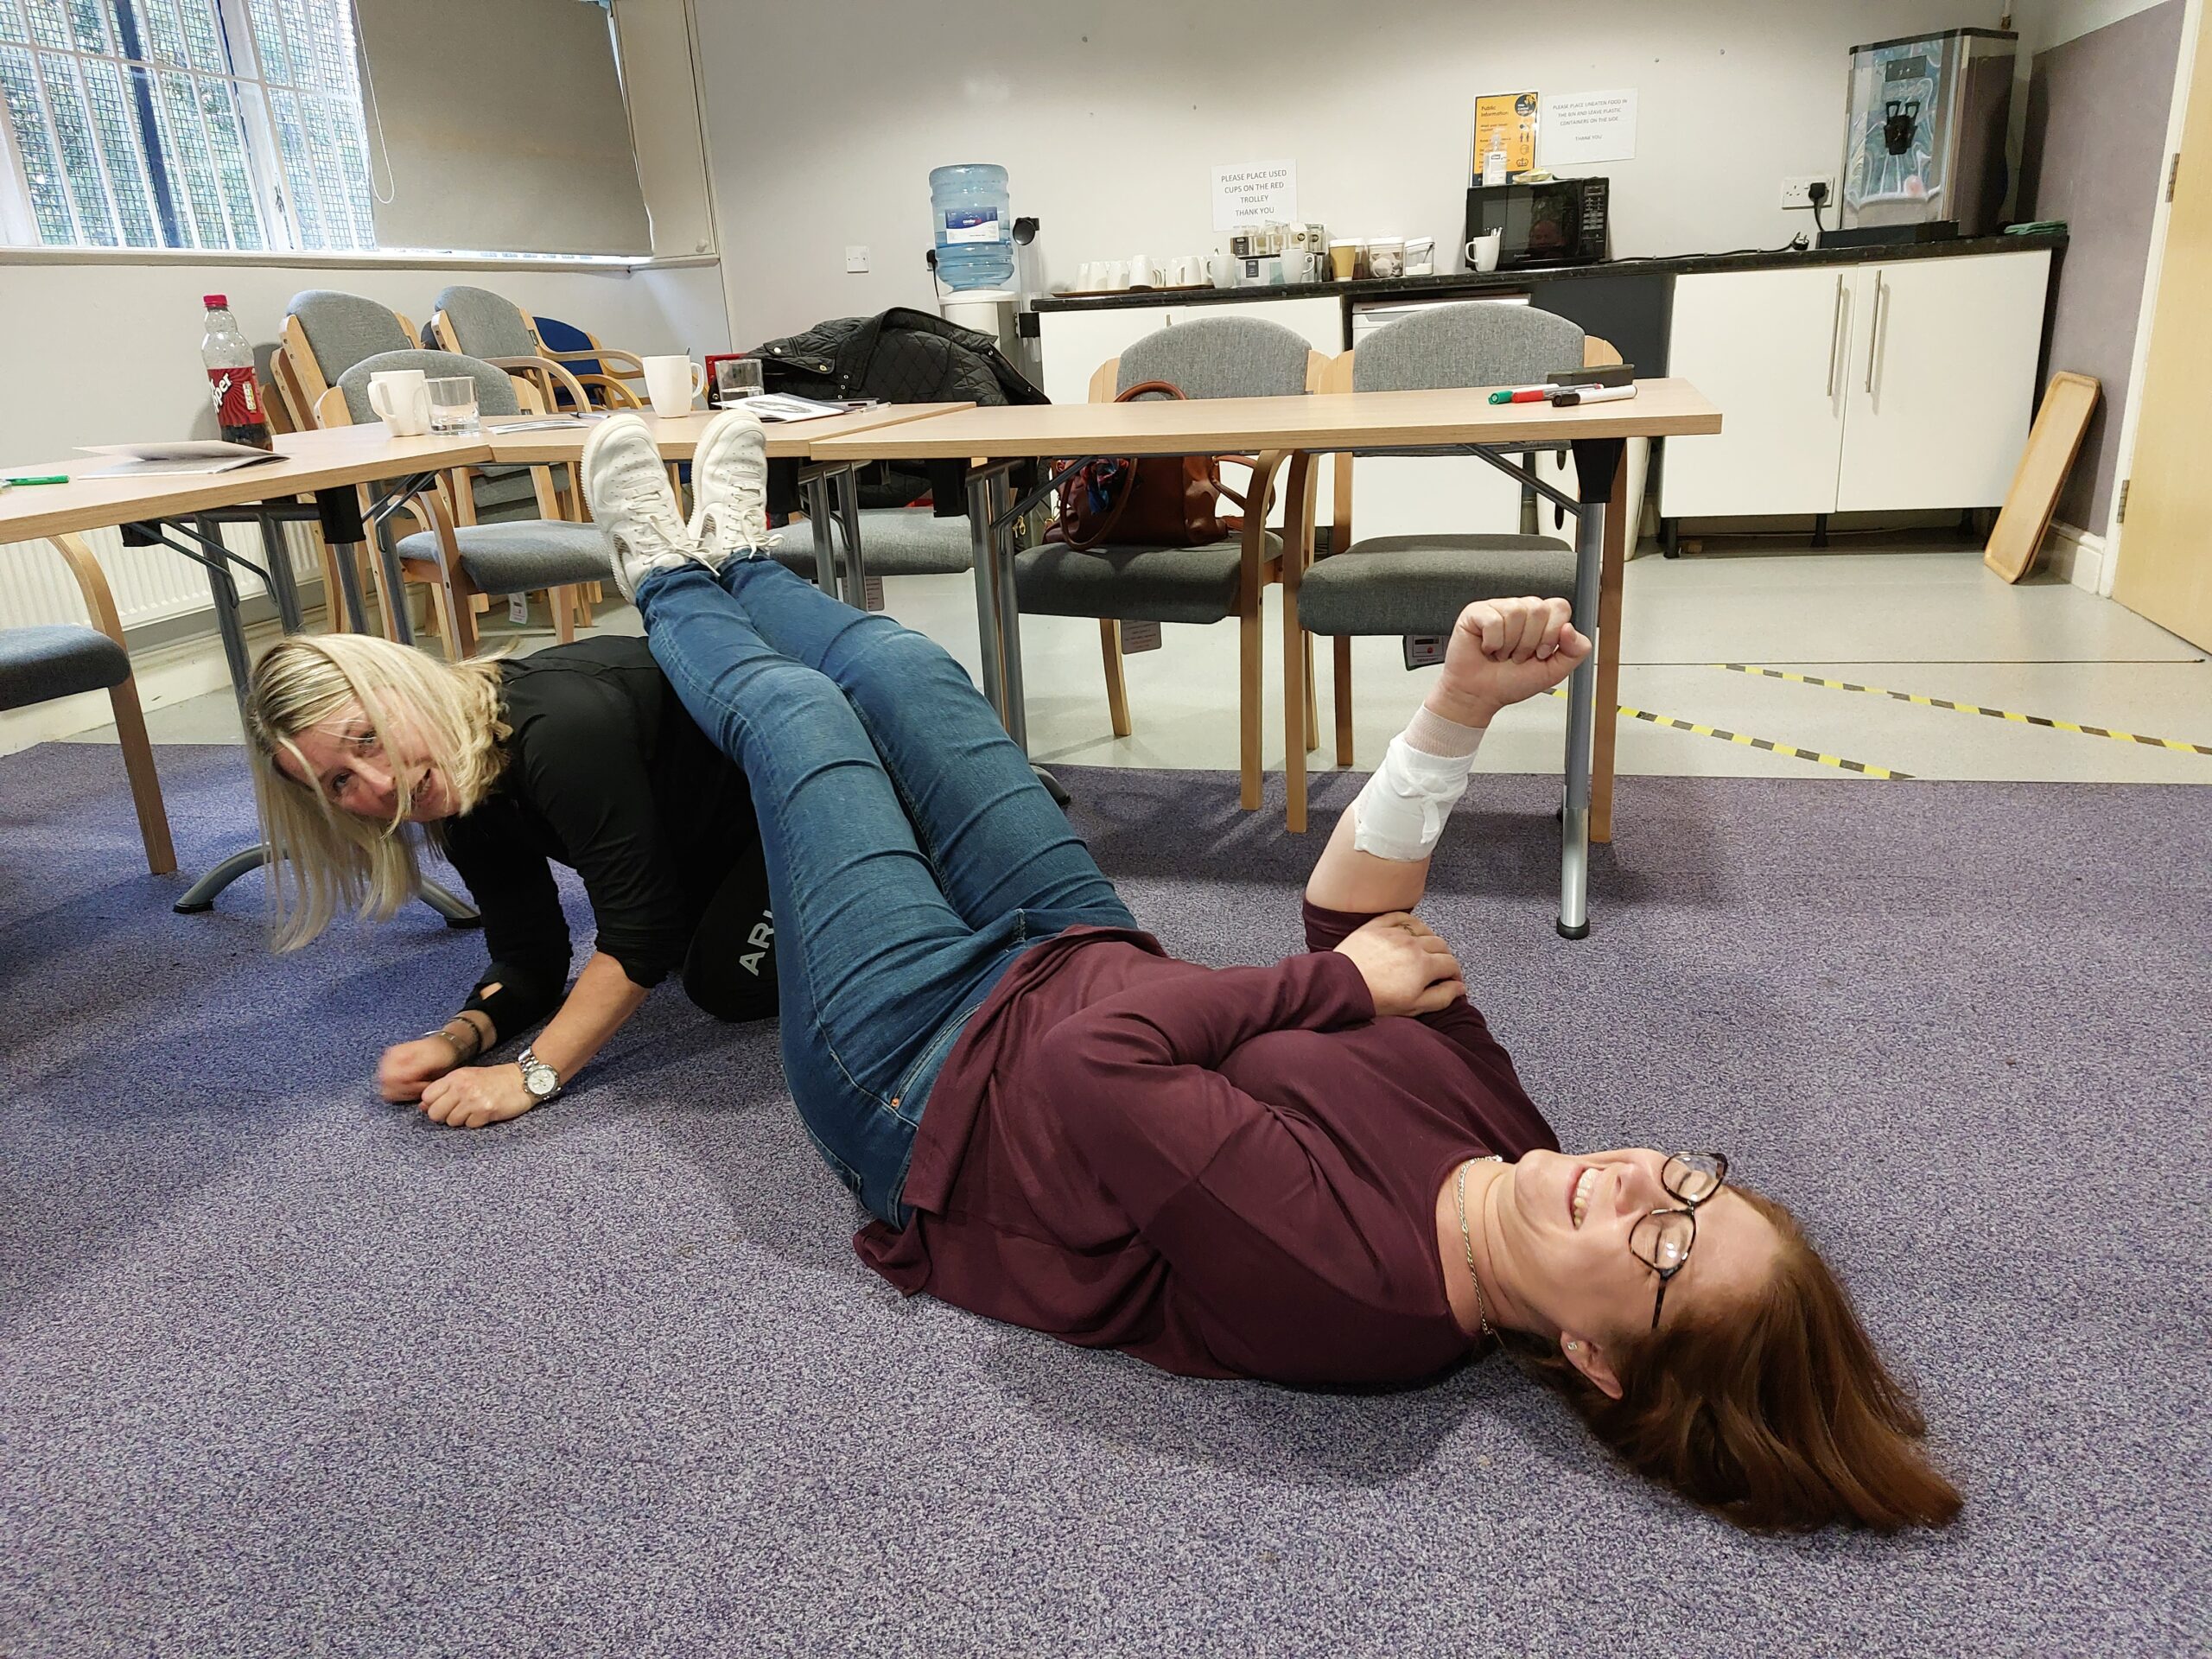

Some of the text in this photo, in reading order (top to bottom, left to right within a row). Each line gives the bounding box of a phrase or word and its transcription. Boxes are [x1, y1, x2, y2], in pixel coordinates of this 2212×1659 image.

[1221, 169, 1287, 182] PLEASE PLACE USED
[1224, 185, 1243, 194] CUPS
[1240, 194, 1268, 204] TROLLEY
[1236, 207, 1259, 216] THANK
